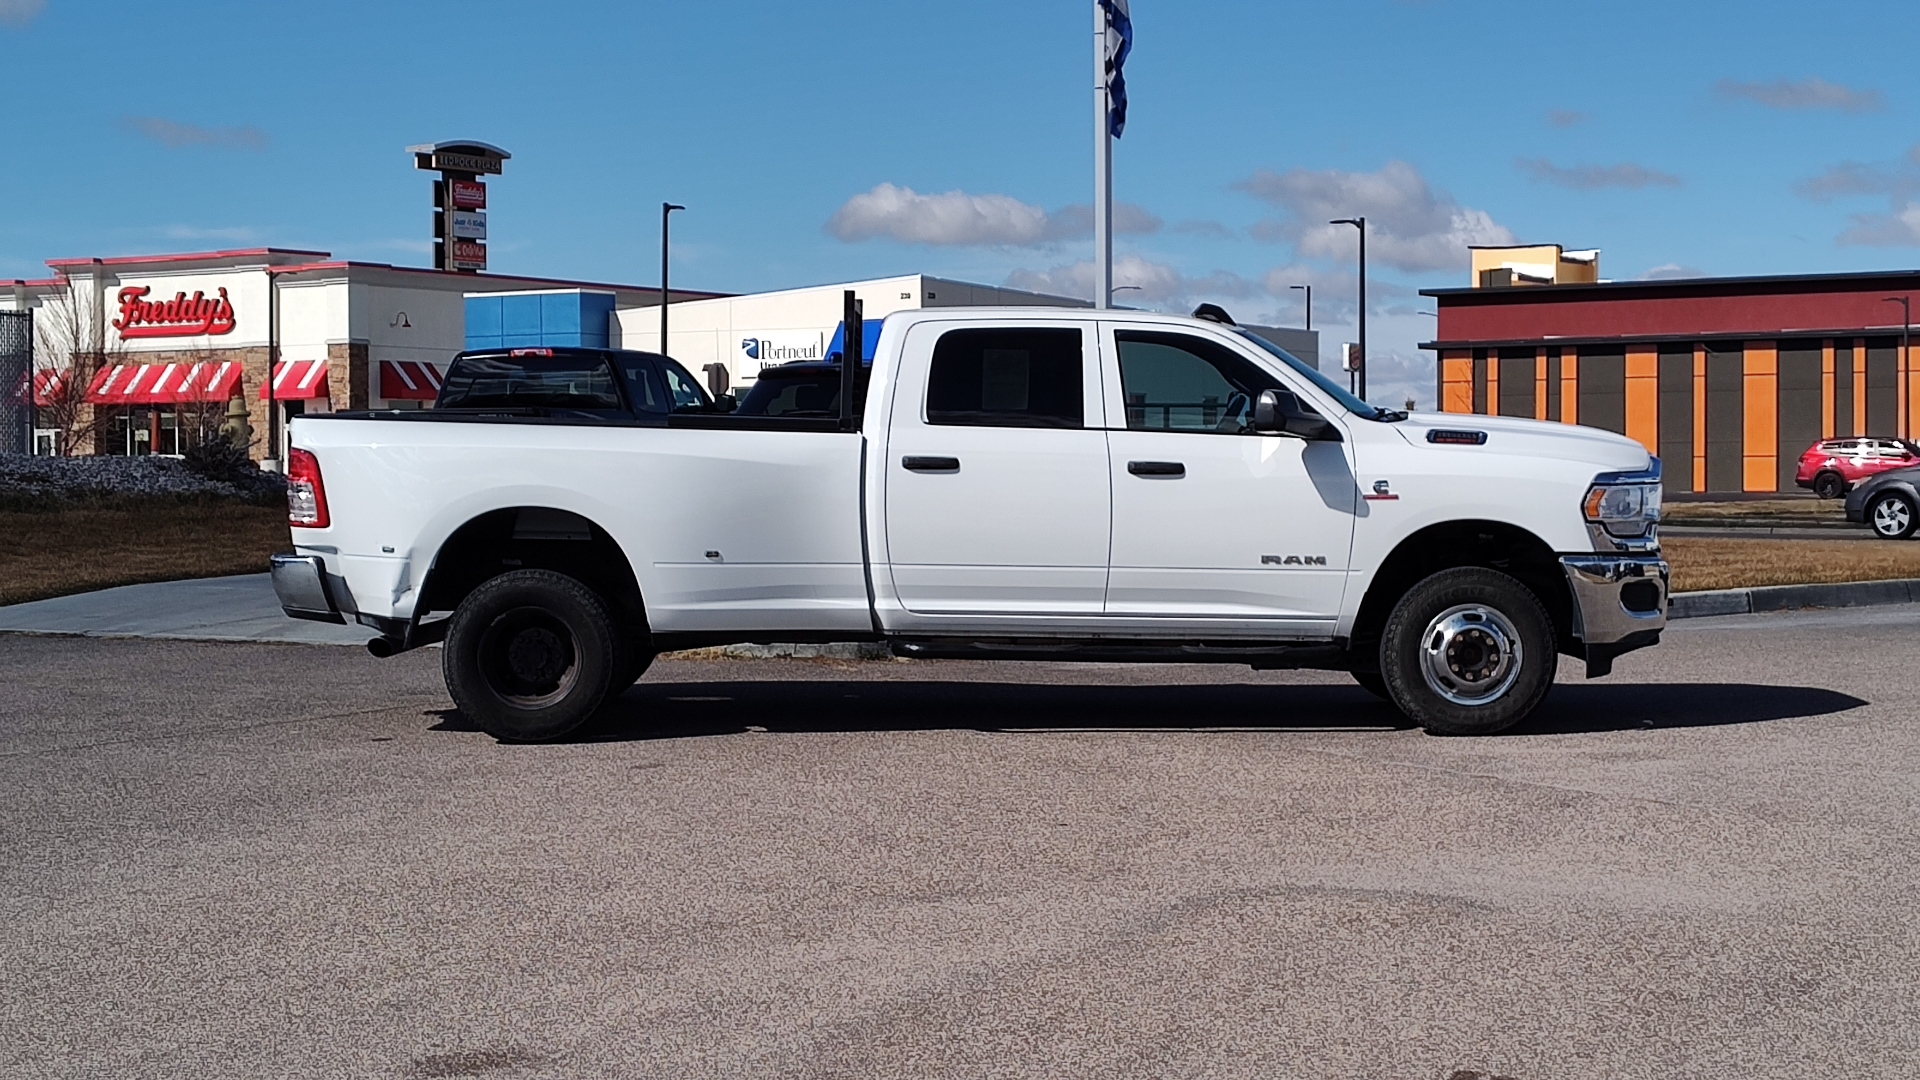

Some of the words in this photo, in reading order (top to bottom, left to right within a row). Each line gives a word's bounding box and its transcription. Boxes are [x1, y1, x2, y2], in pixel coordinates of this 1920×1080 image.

[112, 285, 236, 339] Freddy's
[761, 340, 818, 360] Portneuf
[1261, 555, 1327, 566] RAM
